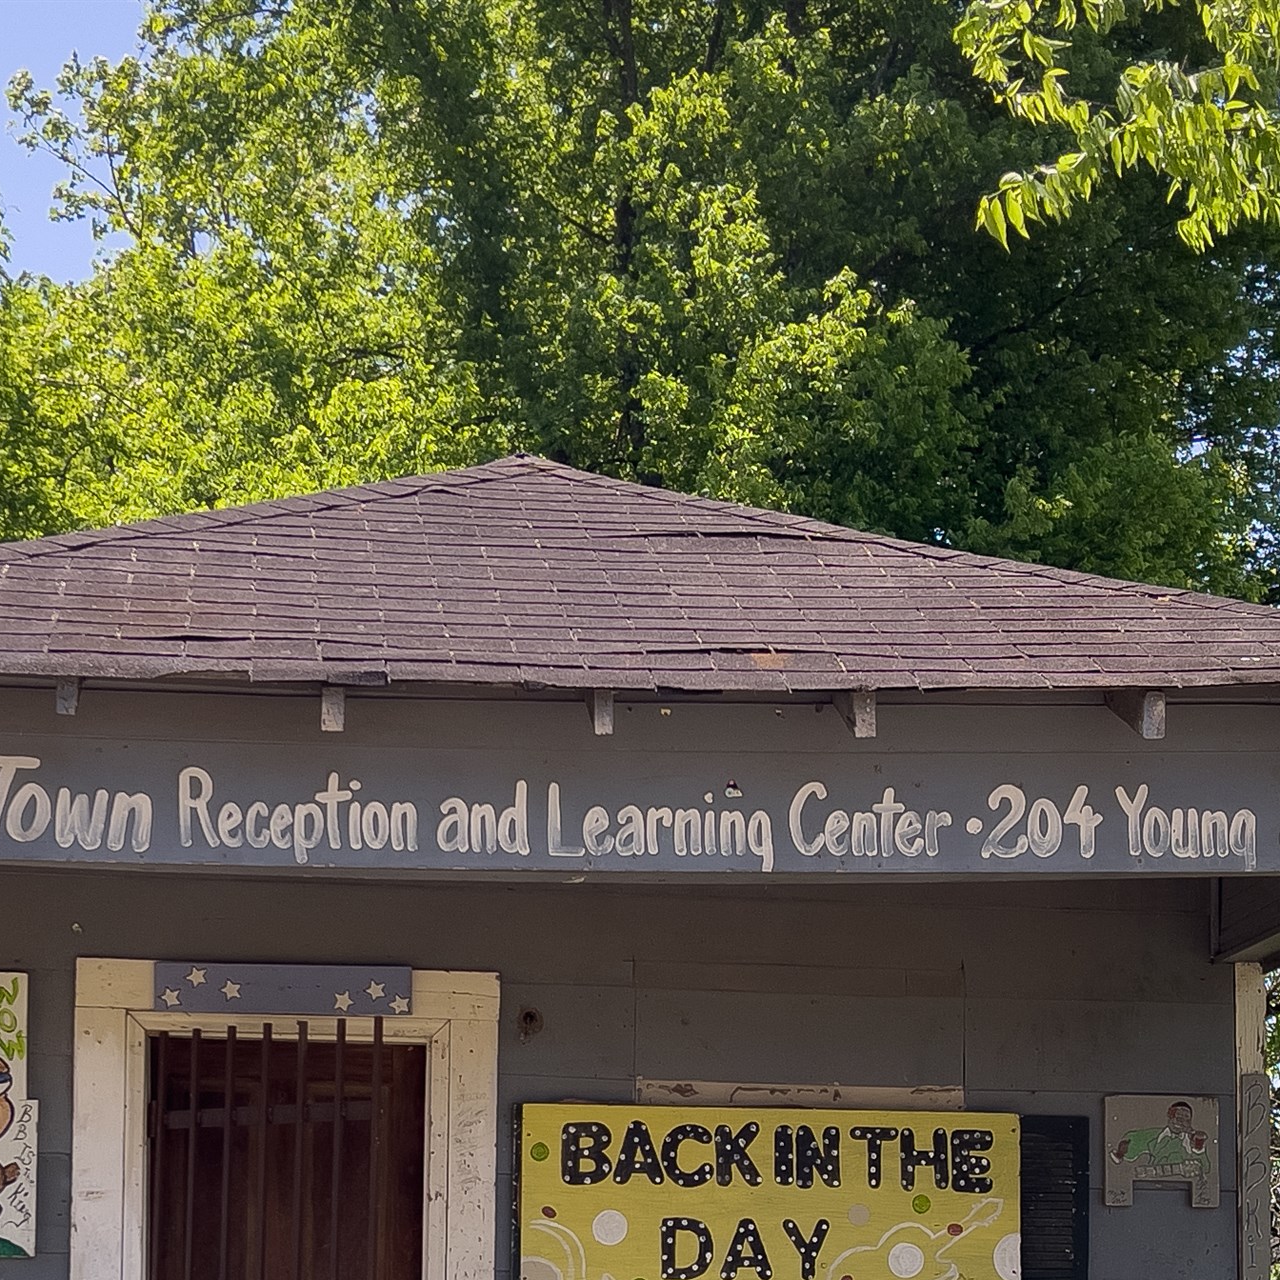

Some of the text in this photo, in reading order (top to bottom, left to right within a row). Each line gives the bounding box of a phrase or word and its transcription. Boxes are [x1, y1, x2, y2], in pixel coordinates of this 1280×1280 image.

[178, 767, 418, 863] Reception
[439, 780, 530, 855] and
[547, 782, 773, 871] Learning
[789, 782, 951, 856] Center
[1116, 785, 1257, 868] Young
[562, 1121, 994, 1193] BACK IN THE
[660, 1217, 830, 1280] DAY
